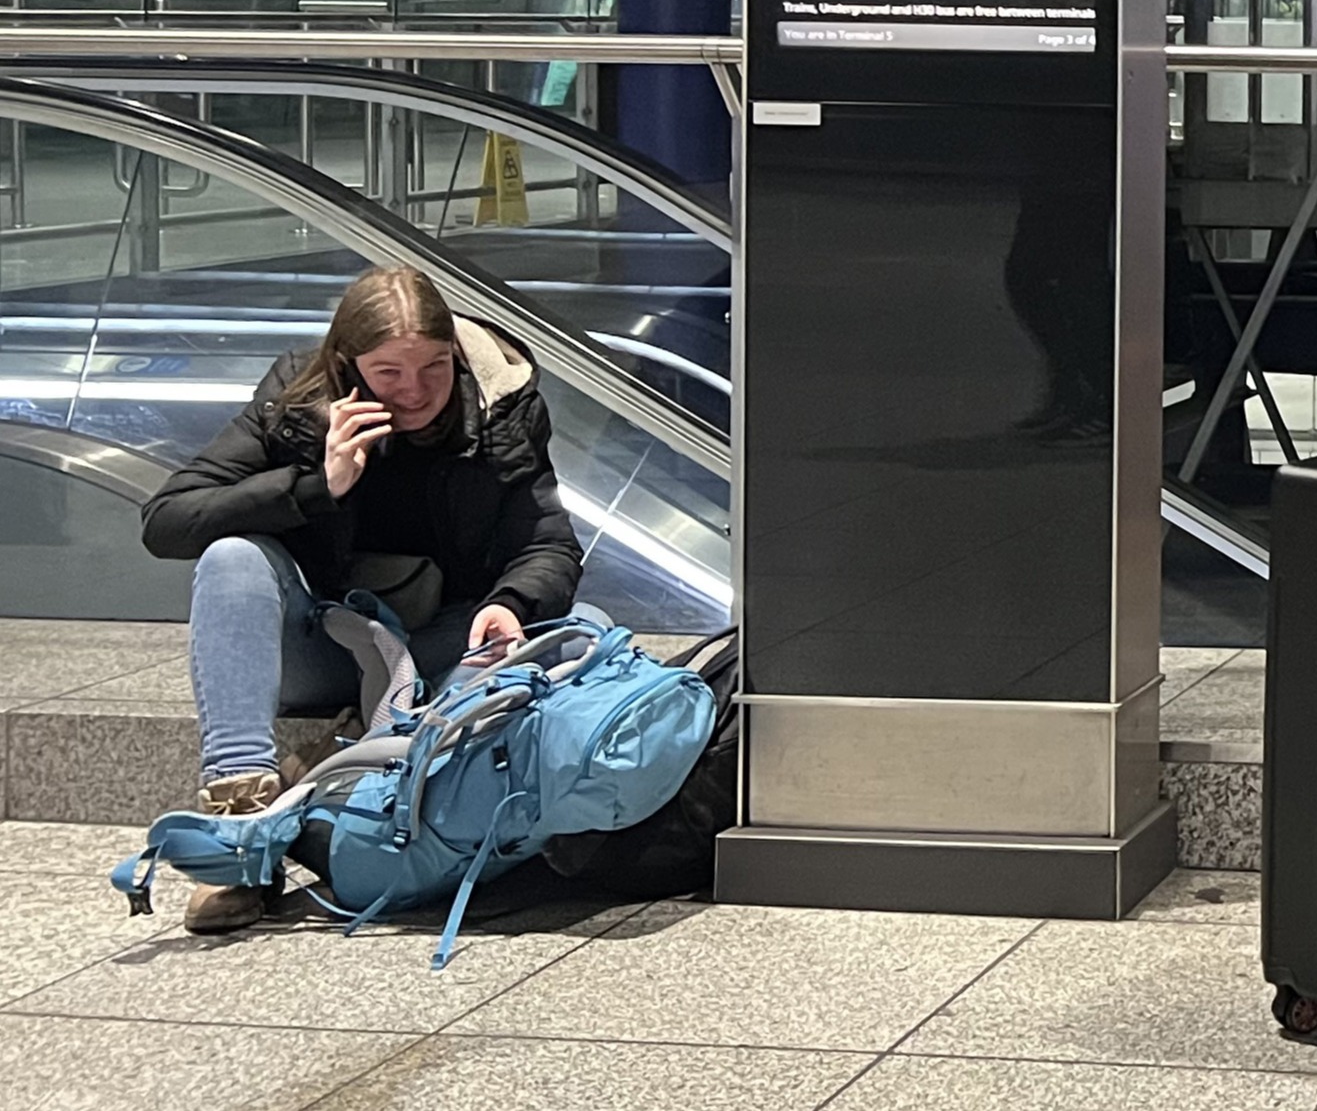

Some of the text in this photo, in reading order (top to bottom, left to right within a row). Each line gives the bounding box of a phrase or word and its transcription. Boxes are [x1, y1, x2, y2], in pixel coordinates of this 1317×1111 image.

[818, 2, 890, 16] Underground
[891, 4, 911, 15] and
[998, 6, 1045, 18] between
[1046, 7, 1096, 19] terminals
[784, 29, 805, 40] You
[808, 31, 824, 40] are
[826, 30, 837, 40] in
[838, 30, 884, 41] Terminal
[1038, 34, 1065, 47] Page
[1075, 34, 1087, 45] of
